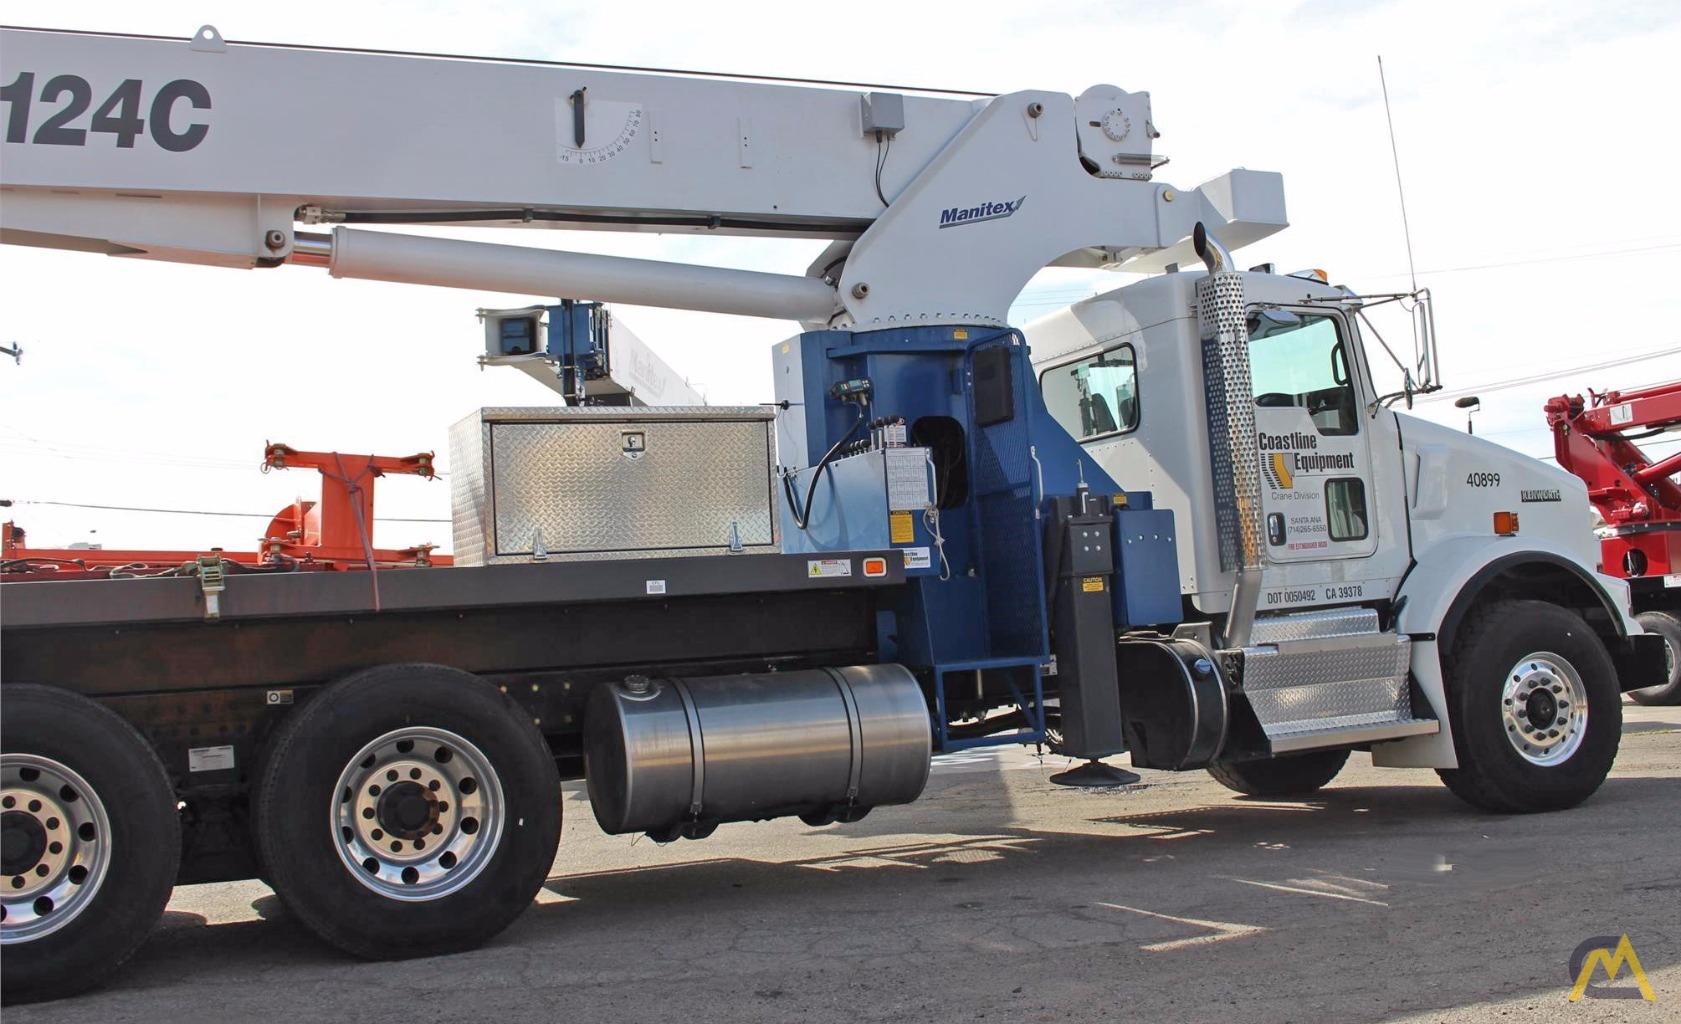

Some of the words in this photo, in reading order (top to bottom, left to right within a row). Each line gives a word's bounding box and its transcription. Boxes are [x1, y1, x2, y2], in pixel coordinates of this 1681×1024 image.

[0, 71, 212, 153] 124C
[940, 201, 1015, 224] Manitex
[1258, 432, 1317, 450] Coastline
[1294, 452, 1355, 473] Equipment
[1466, 472, 1501, 488] 40899
[1271, 492, 1292, 501] Crane
[1293, 490, 1320, 499] Division
[1520, 489, 1562, 503] KENWORTH
[1267, 592, 1282, 604] DOT
[1284, 589, 1316, 603] 0050492
[1325, 588, 1337, 600] CA
[1338, 586, 1362, 598] 39378
